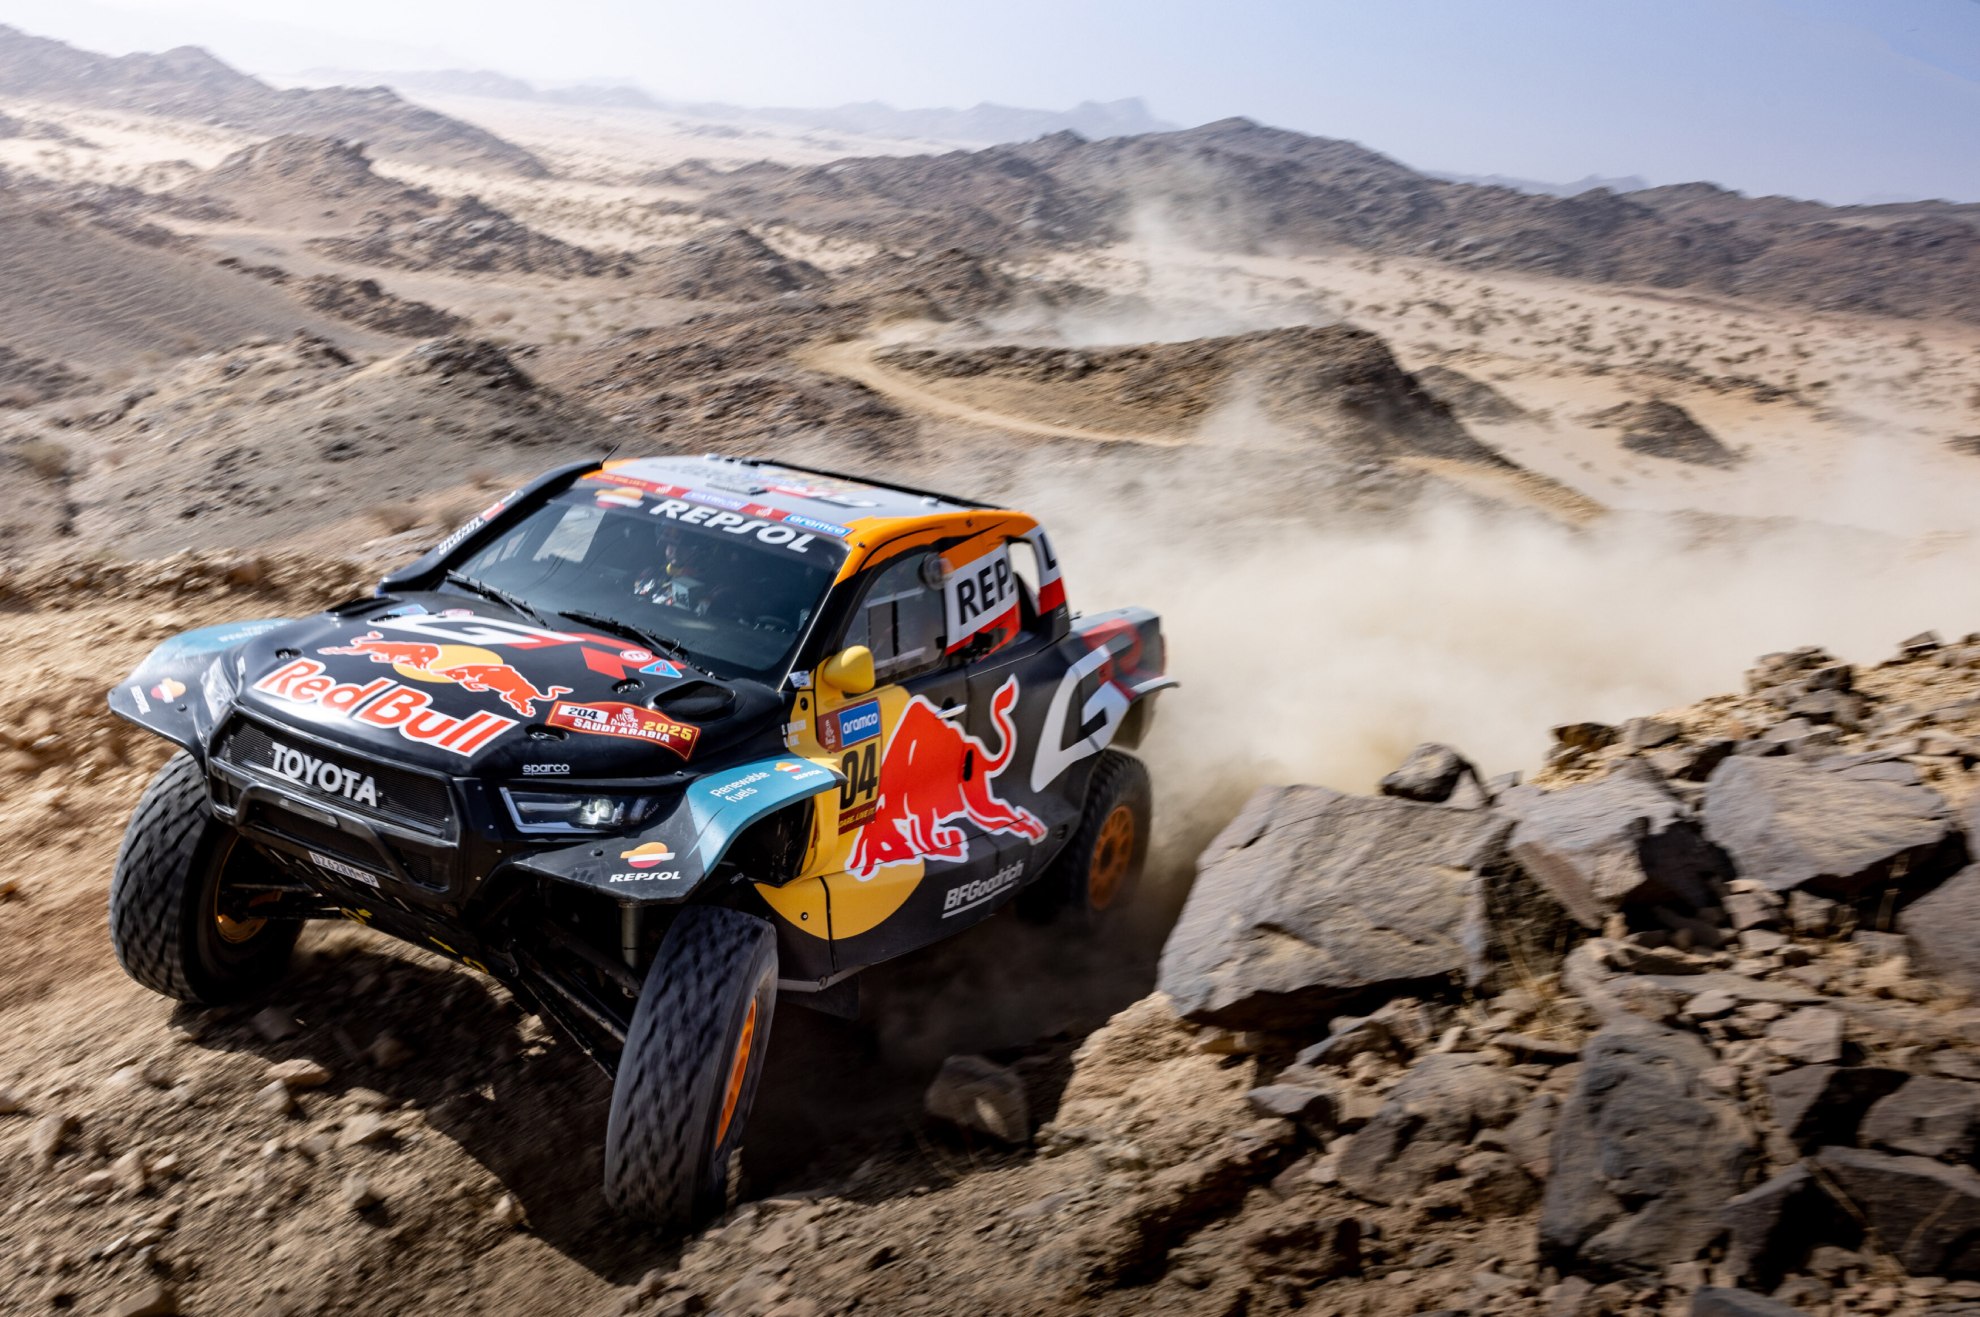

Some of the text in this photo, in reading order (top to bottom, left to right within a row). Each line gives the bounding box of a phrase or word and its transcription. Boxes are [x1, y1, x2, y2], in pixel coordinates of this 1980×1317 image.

[650, 499, 817, 553] REPSOL
[789, 514, 847, 536] aramco
[957, 557, 1015, 626] REP
[252, 657, 520, 757] Red Bull
[568, 707, 598, 719] 204
[573, 718, 670, 743] SAUDI ARABIA
[643, 720, 693, 741] 2025
[842, 712, 878, 734] aramco
[272, 742, 377, 807] TOYOTA
[522, 763, 570, 775] sparco
[839, 742, 878, 810] 04
[709, 771, 770, 797] Renewable
[724, 787, 758, 803] fuels
[609, 871, 681, 883] REPSOL
[943, 860, 1024, 910] BFGoodrich
